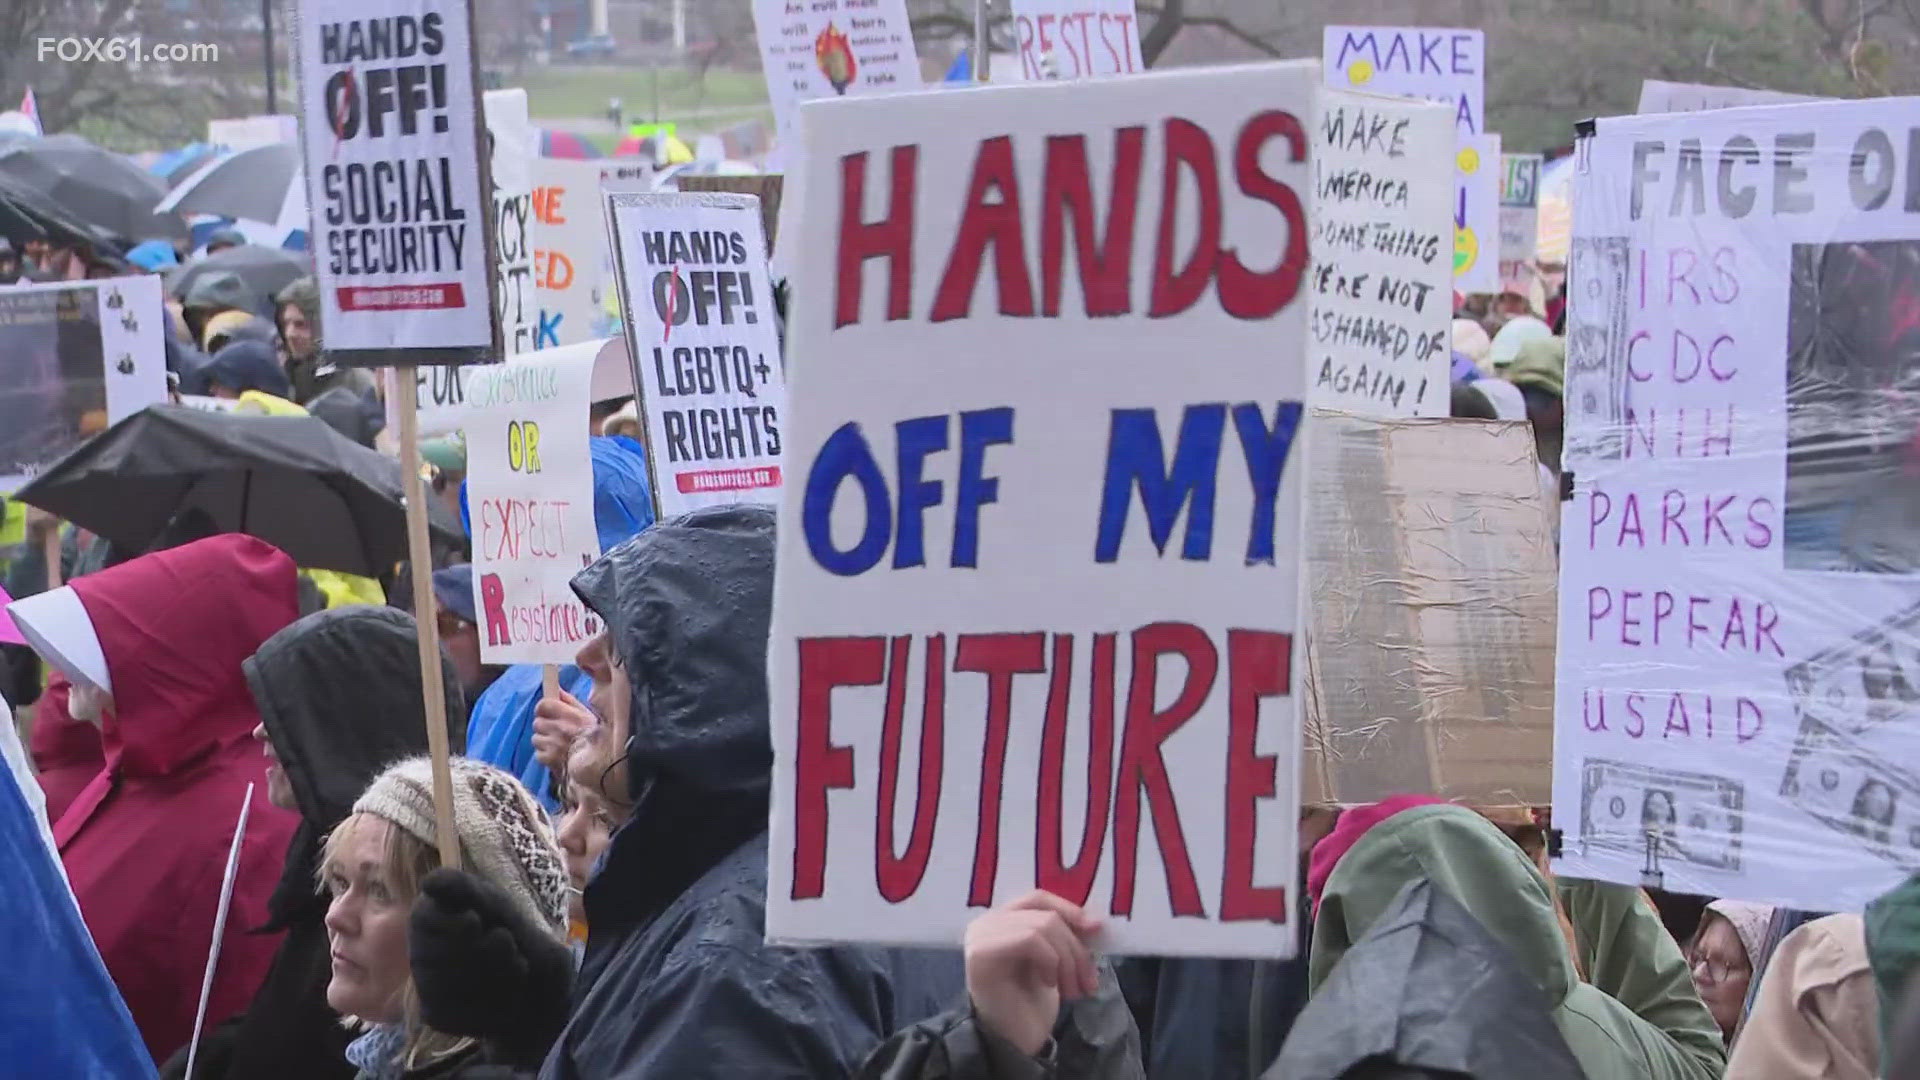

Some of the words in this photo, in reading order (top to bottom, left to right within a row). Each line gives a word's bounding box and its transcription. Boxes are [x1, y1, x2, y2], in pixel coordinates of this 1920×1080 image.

[321, 12, 443, 64] HANDS
[1337, 32, 1474, 75] MAKE
[325, 64, 449, 141] OFF!
[1321, 107, 1410, 158] MAKE
[324, 157, 466, 225] SOCIAL
[1630, 132, 1815, 221] FACE
[834, 109, 1310, 330] HANDS
[1312, 211, 1439, 265] OMETHING
[328, 224, 465, 275] SECURITY
[642, 231, 747, 265] HANDS
[652, 271, 758, 326] OFF!
[1379, 275, 1434, 314] NOT
[1640, 247, 1739, 309] IRS
[653, 346, 771, 398] LGBTQ+
[1415, 330, 1445, 361] OF
[1628, 330, 1738, 383] CDC
[508, 420, 542, 474] OR
[663, 405, 781, 462] RIGHTS
[1624, 403, 1735, 459] NIH
[803, 407, 1015, 577] OFF
[1094, 400, 1303, 567] MY
[481, 498, 570, 561] EXPECT
[1589, 489, 1776, 550] PARKS
[1588, 586, 1785, 658] PEPFAR
[1583, 687, 1764, 744] USAID
[791, 621, 1293, 923] FUTURE
